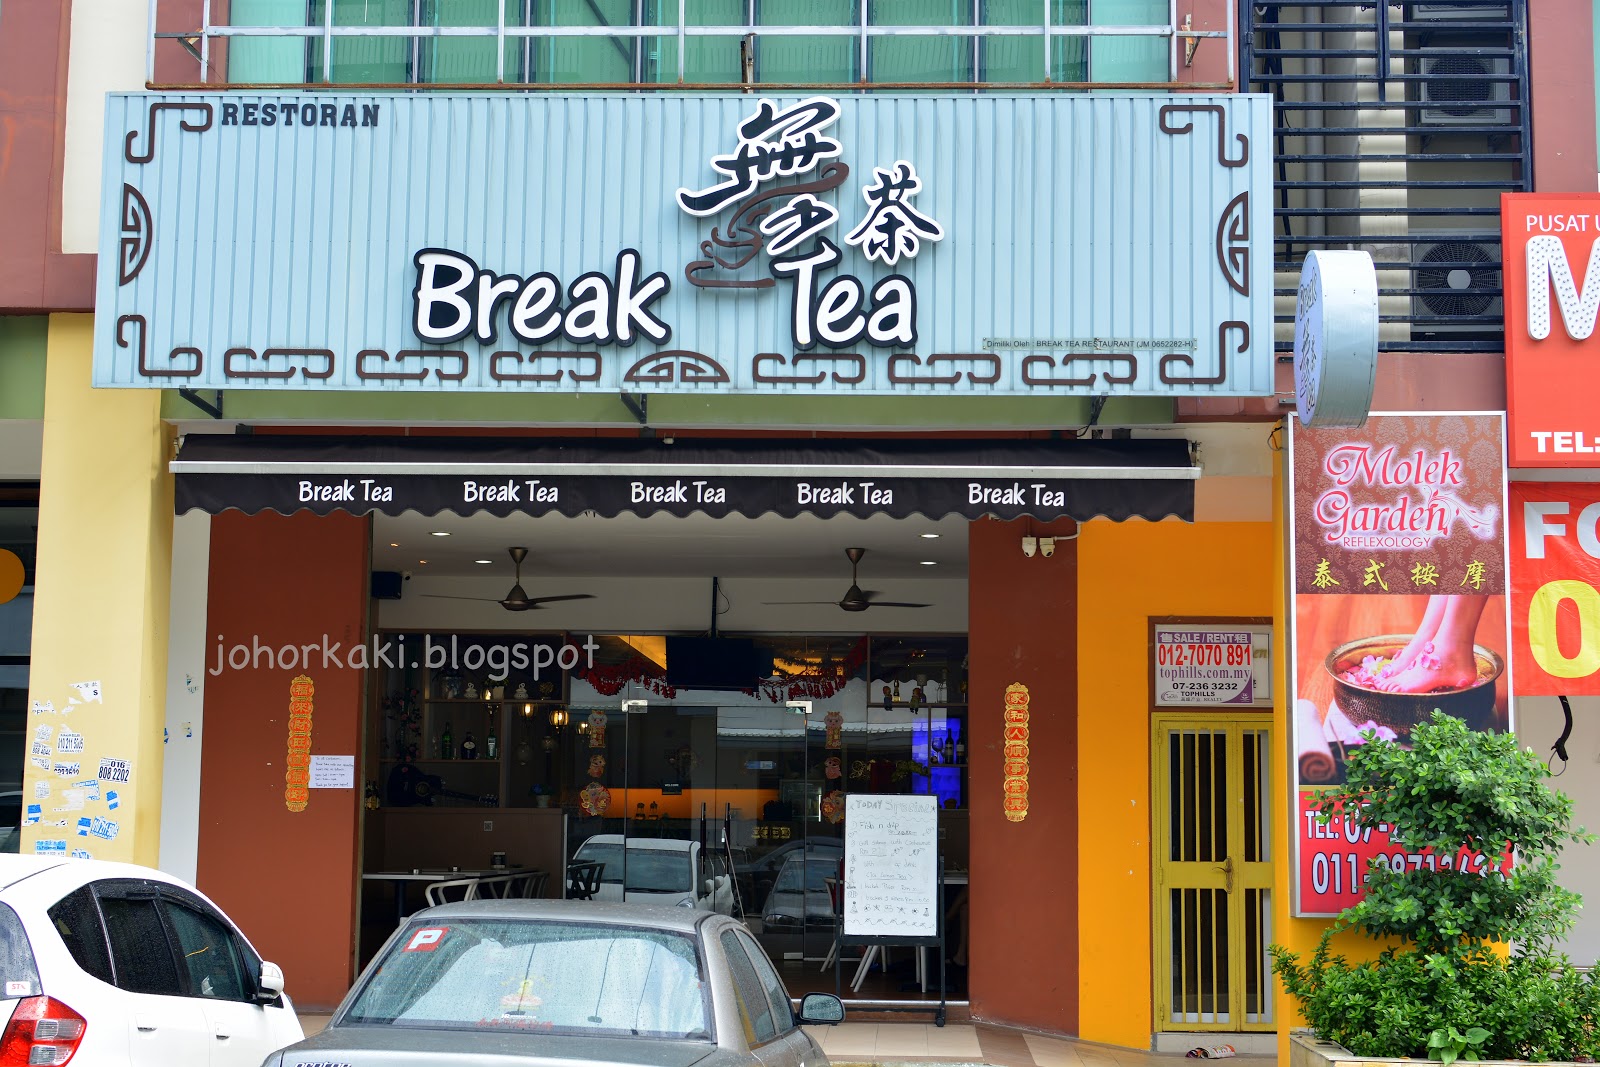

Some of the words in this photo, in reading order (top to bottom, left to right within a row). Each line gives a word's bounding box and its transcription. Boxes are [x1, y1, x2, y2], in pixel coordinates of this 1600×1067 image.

[222, 103, 380, 128] RESTORAN
[1526, 214, 1590, 232] PUSAT
[413, 247, 672, 346] Break
[769, 236, 919, 351] Tea
[986, 339, 1012, 349] Dimiliki
[1013, 339, 1030, 348] Oleh
[1036, 340, 1063, 348] BREAK
[1065, 340, 1080, 348] TEA
[1082, 340, 1135, 348] RESTAURANT
[1136, 340, 1150, 349] (JM
[1151, 340, 1194, 349] 0652282-H)
[1326, 445, 1462, 485] Molek
[299, 480, 356, 502] Break
[361, 481, 393, 503] Tea
[465, 480, 521, 503] Break
[527, 481, 559, 504] Tea
[632, 481, 688, 503] Break
[694, 482, 726, 504] Tea
[798, 482, 855, 505] Break
[861, 483, 893, 506] Tea
[969, 483, 1026, 506] Break
[1032, 484, 1065, 507] Tea
[1316, 490, 1448, 541] Garden
[1343, 536, 1432, 548] REFLEXOLOGY
[1311, 558, 1487, 591] 泰式按摩
[1158, 644, 1222, 666] 012-7070
[1226, 644, 1251, 666] 891
[1160, 666, 1251, 682] tophills.com.my
[1172, 682, 1209, 690] 07-236
[1211, 682, 1238, 690] 3232
[98, 766, 112, 779] 808
[112, 767, 129, 781] 2202
[110, 760, 125, 769] 016
[407, 930, 443, 950] P
